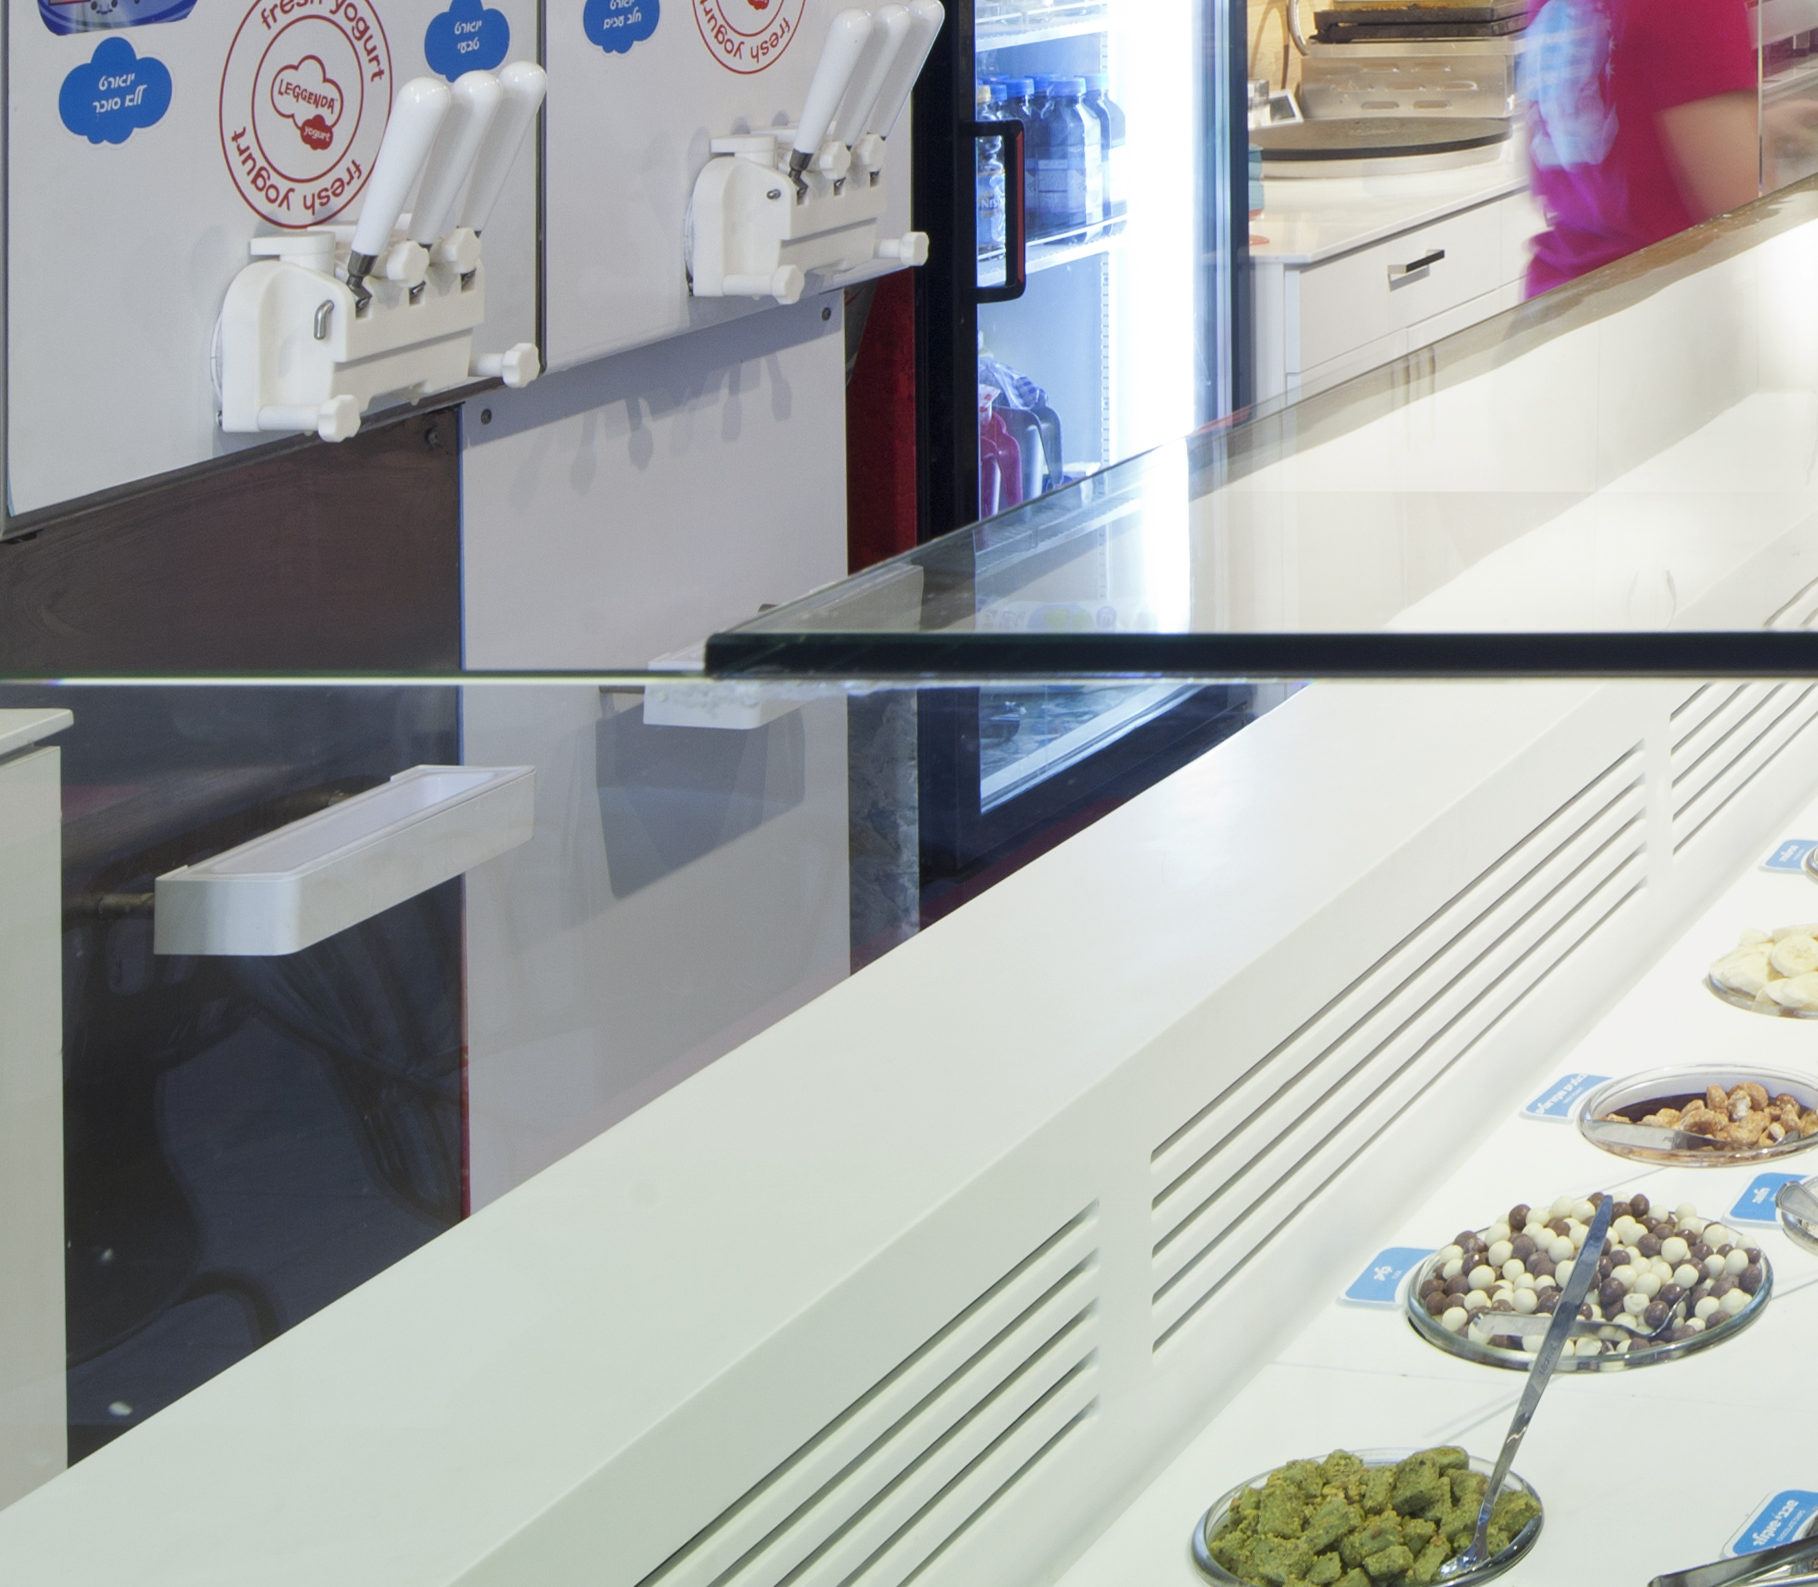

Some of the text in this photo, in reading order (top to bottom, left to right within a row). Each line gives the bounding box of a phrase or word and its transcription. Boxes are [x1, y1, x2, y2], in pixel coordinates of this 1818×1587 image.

[454, 20, 482, 35] יוגורט
[457, 40, 480, 54] טבעי
[751, 17, 790, 63] fresh
[98, 73, 135, 91] יוגורט
[92, 84, 147, 113] ללא סוכר
[278, 78, 335, 114] LEGGENDA
[303, 125, 331, 141] yogurt
[231, 126, 362, 215] fresh yogurt
